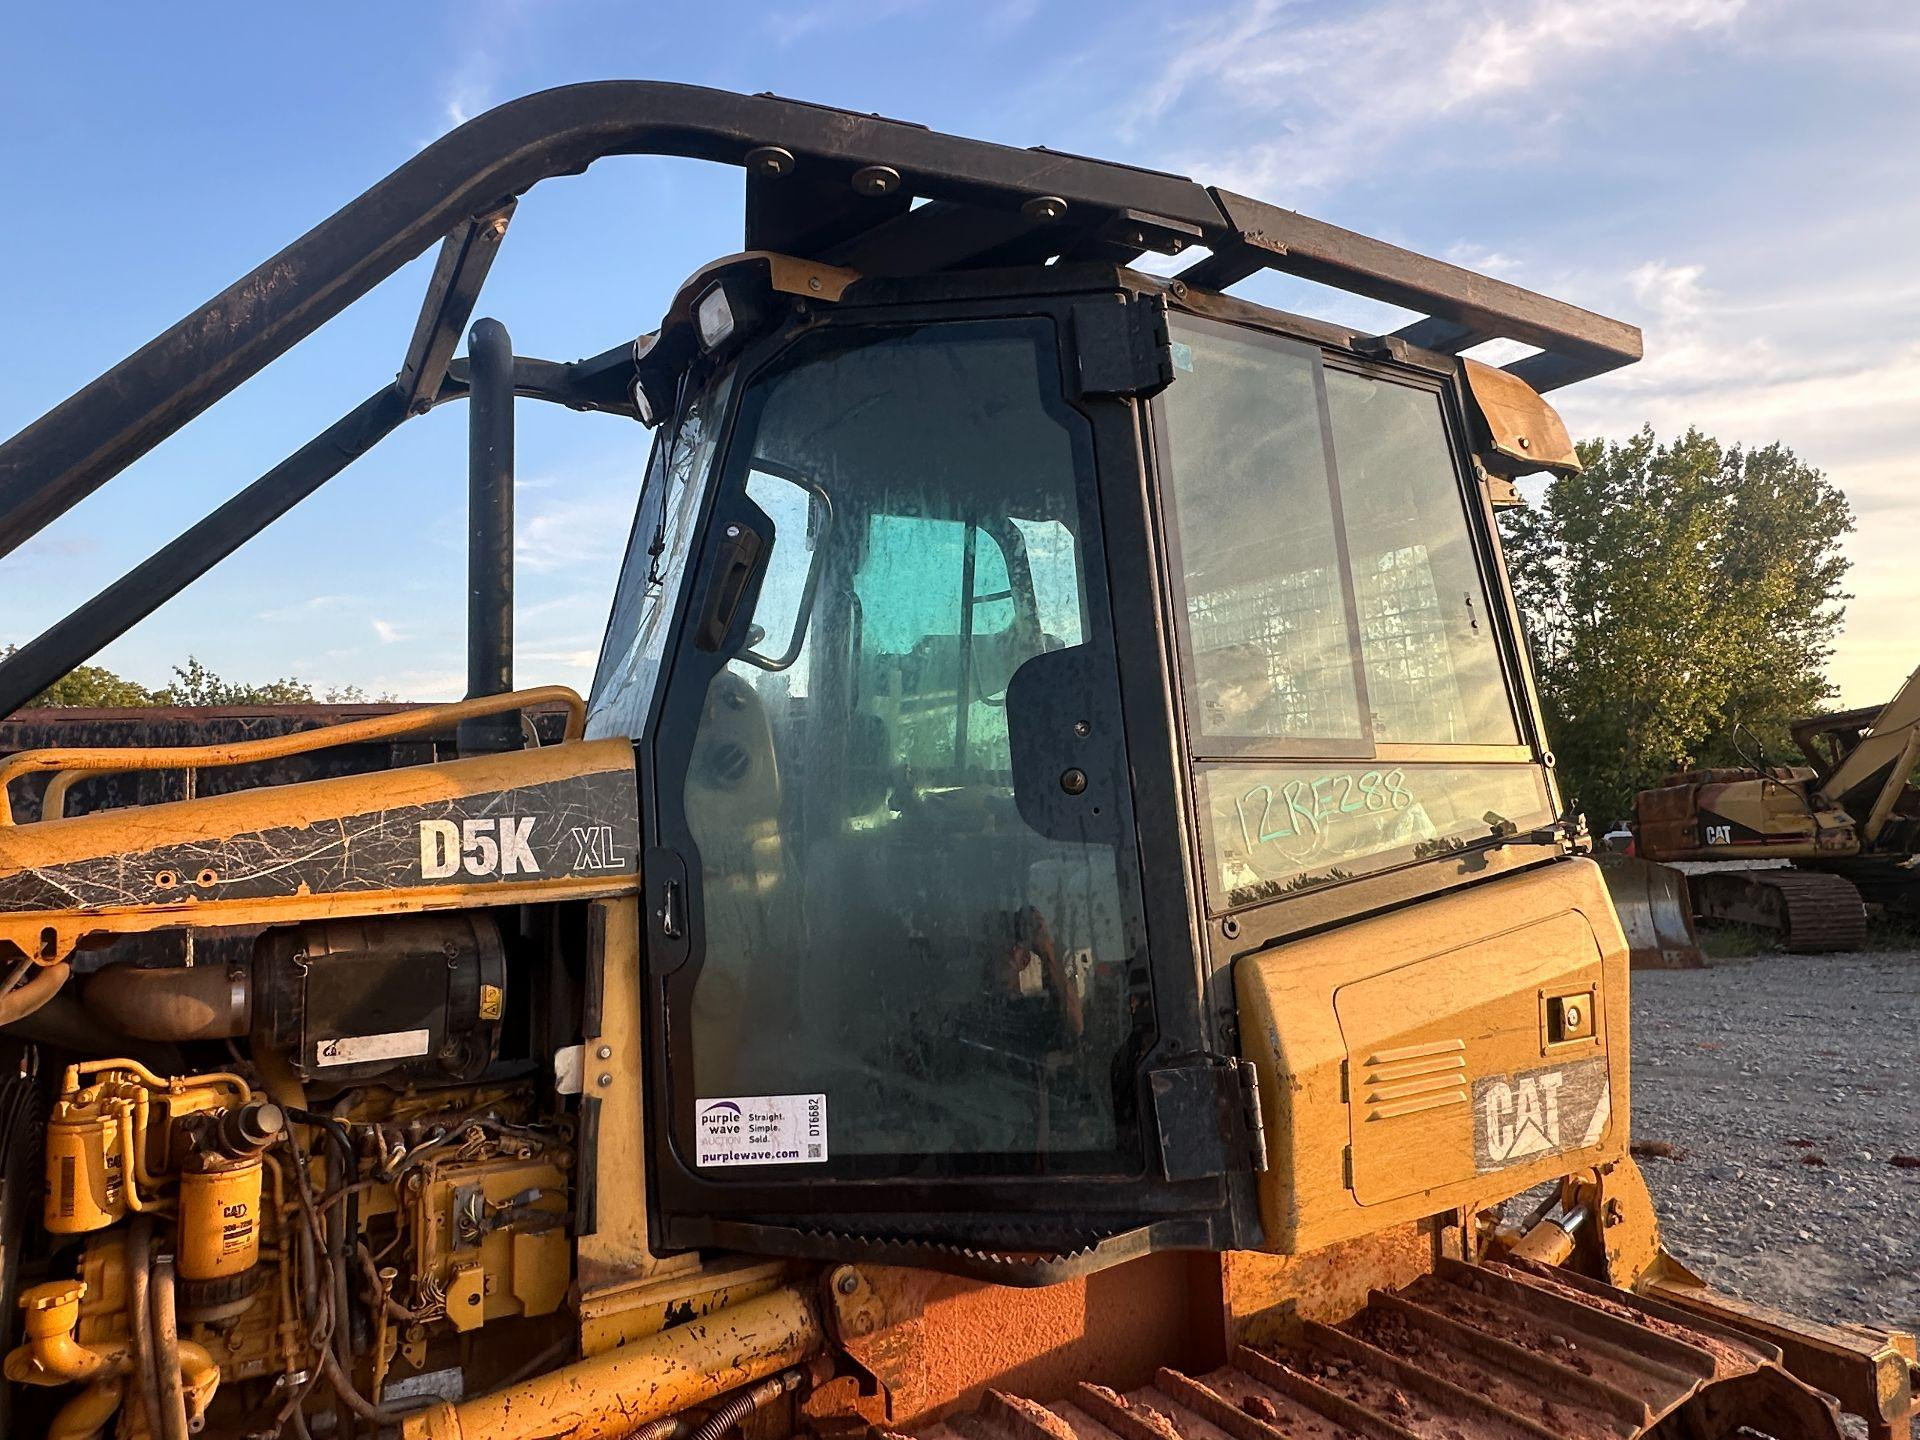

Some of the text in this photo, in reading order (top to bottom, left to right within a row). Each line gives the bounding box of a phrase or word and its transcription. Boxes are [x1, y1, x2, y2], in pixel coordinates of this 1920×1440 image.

[1706, 825, 1731, 845] CAT
[420, 817, 625, 879] D5K XL
[701, 1112, 740, 1125] purple
[749, 1113, 785, 1122] Straight.
[808, 1099, 819, 1136] DT6682
[1486, 1072, 1563, 1161] CAT
[709, 1125, 740, 1134] wave
[749, 1124, 780, 1132] Simple.
[701, 1137, 740, 1146] AUCTION
[702, 1150, 799, 1163] purplewave.com
[223, 1204, 247, 1218] CAT
